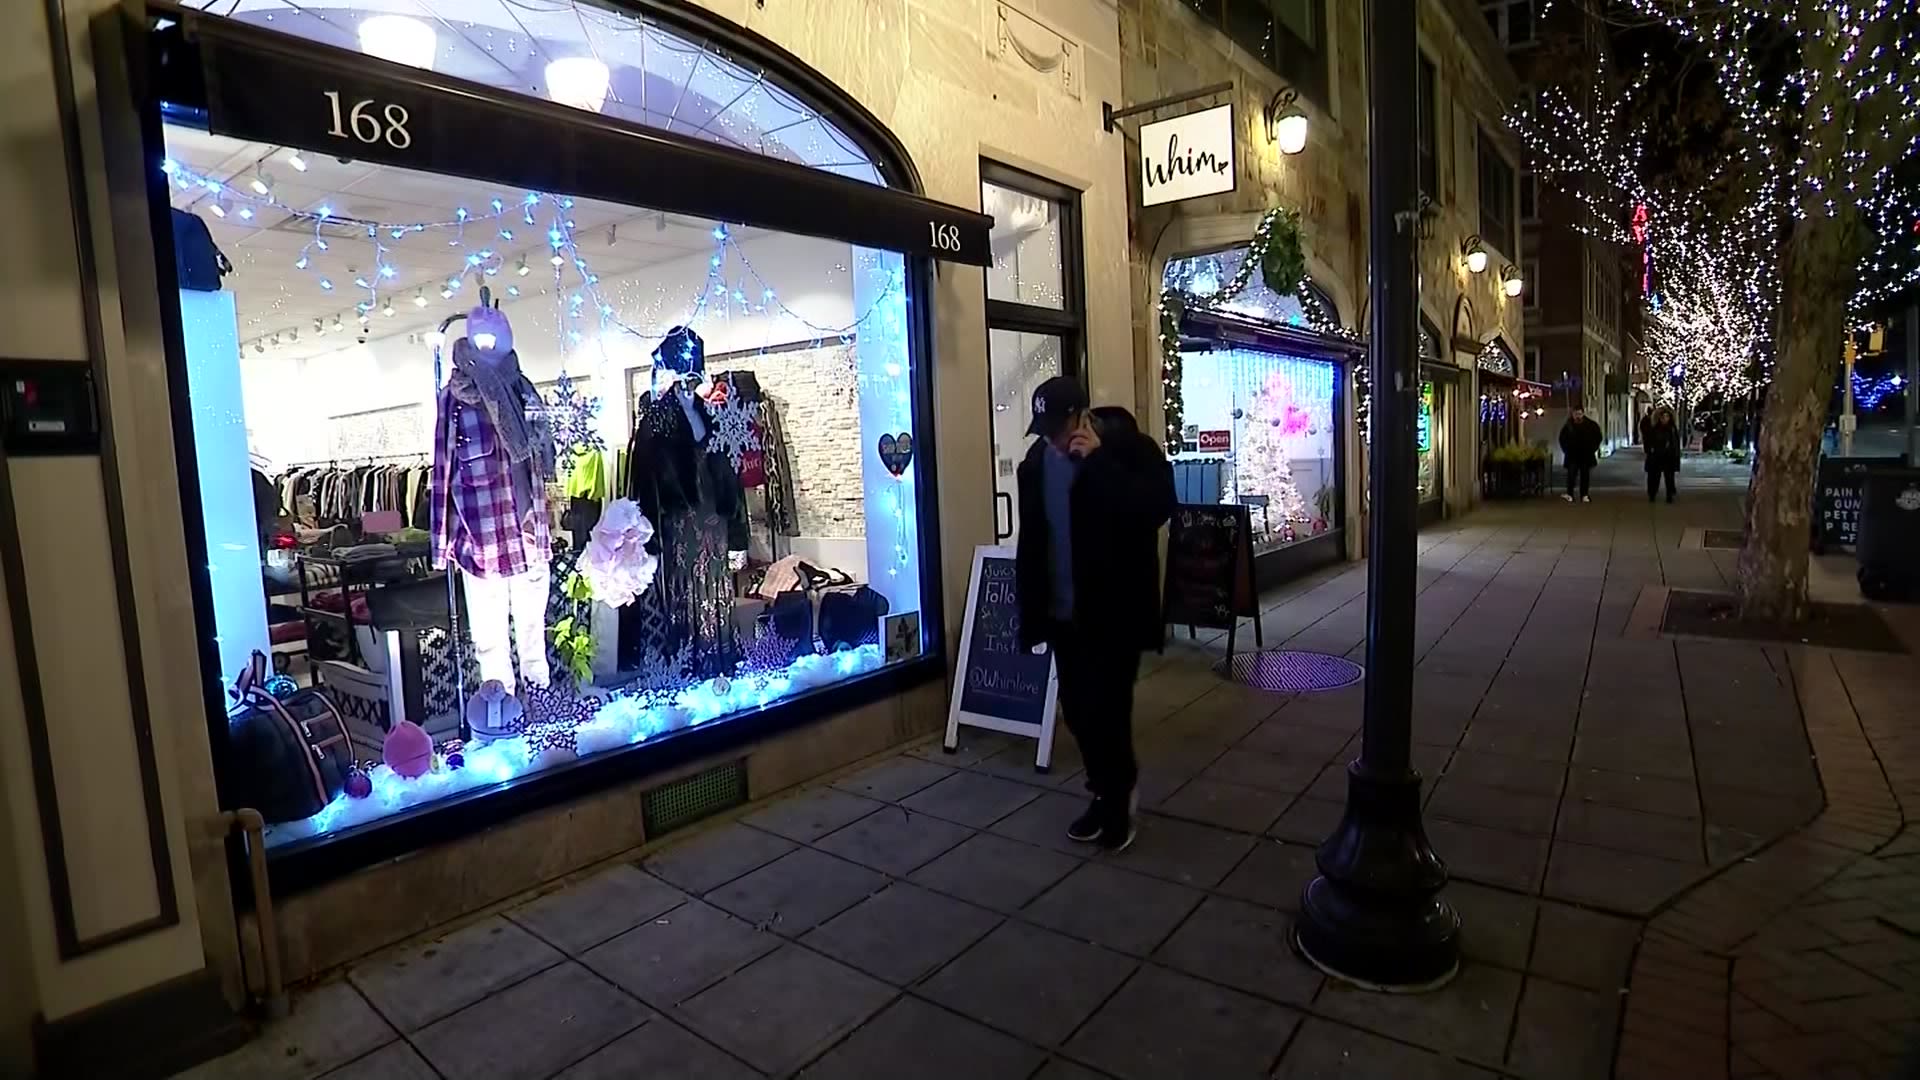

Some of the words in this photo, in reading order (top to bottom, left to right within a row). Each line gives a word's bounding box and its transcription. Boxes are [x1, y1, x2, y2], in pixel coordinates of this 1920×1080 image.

[323, 91, 411, 149] 168
[929, 221, 961, 252] 168
[1200, 433, 1229, 446] Open
[985, 581, 1016, 605] Follo
[983, 634, 1017, 655] Inst
